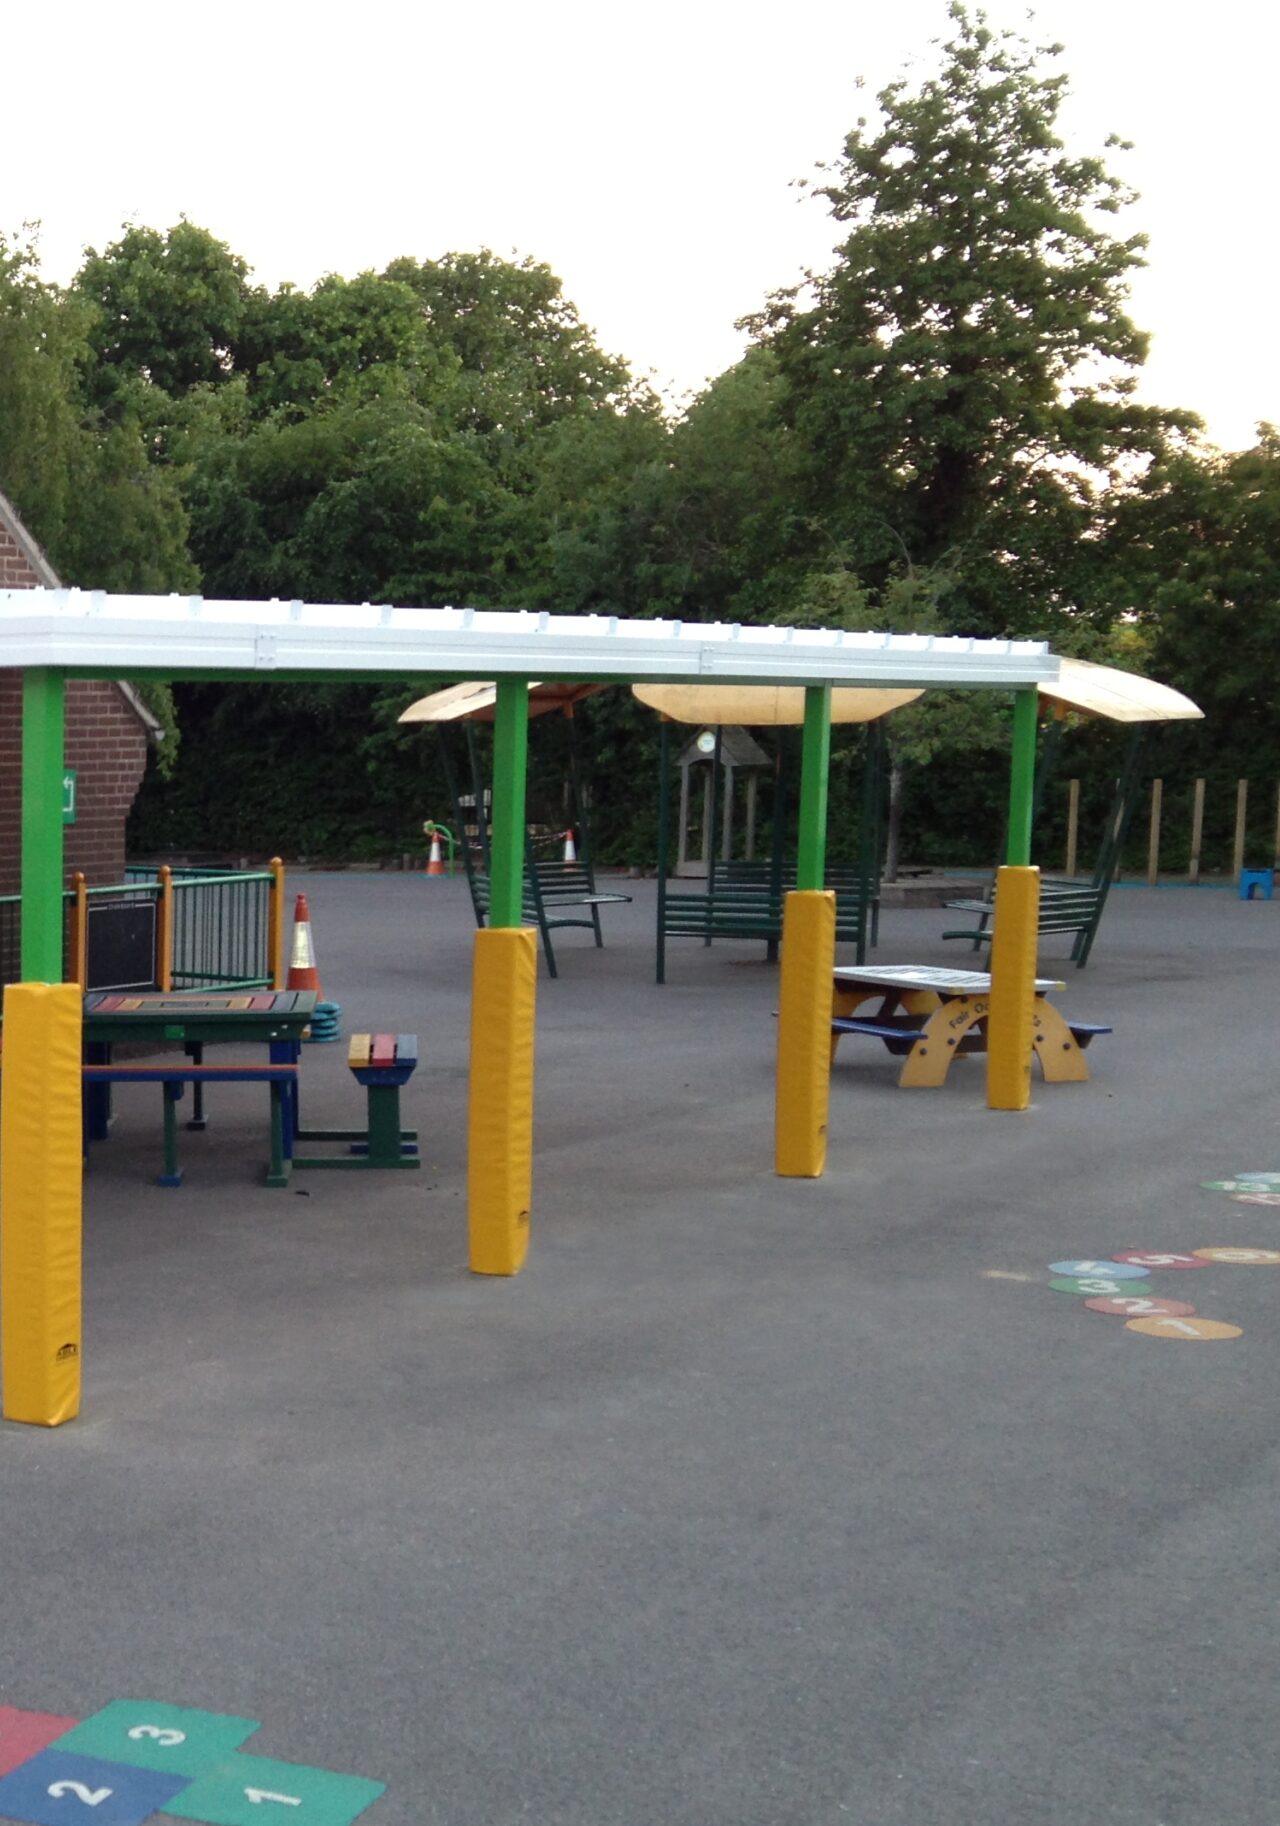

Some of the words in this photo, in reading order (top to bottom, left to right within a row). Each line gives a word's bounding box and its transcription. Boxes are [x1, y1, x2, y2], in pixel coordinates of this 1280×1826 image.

[1074, 1260, 1116, 1275] 4
[1127, 1254, 1194, 1265] 5
[1077, 1279, 1121, 1293] 3
[1111, 1298, 1169, 1313] 2
[1154, 1319, 1201, 1336] 1
[128, 1725, 186, 1746] 3
[47, 1780, 113, 1806] 2
[243, 1787, 302, 1806] 1
